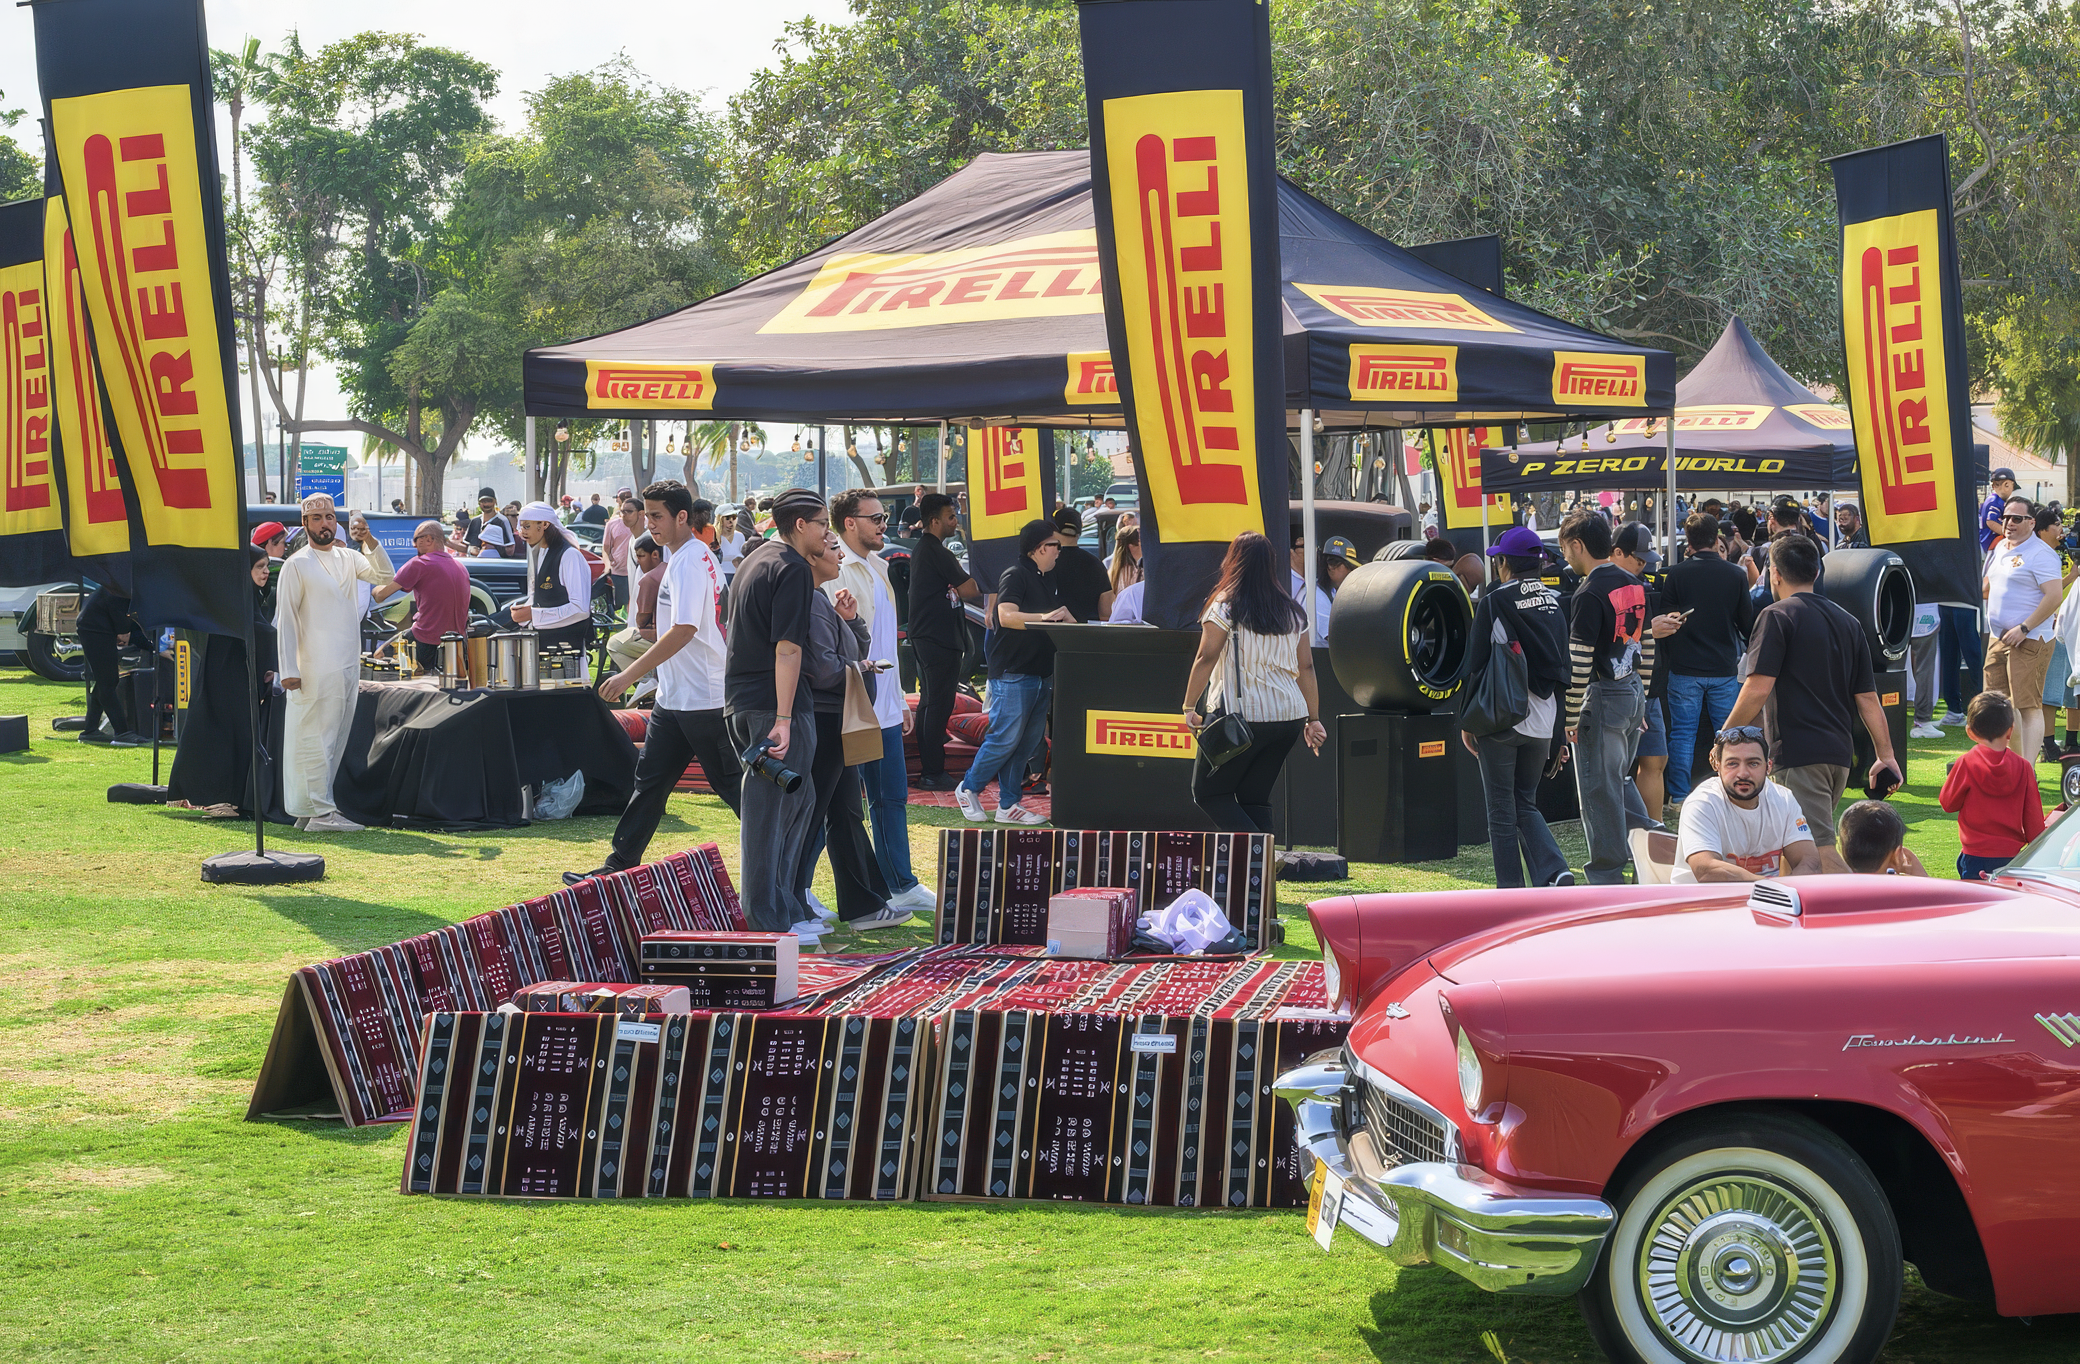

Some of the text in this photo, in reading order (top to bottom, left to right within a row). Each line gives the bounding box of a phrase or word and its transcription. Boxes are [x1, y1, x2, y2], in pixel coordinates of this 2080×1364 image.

[83, 133, 212, 510] PIRELLI
[1135, 133, 1249, 506] PIRELLI
[1319, 294, 1493, 327] PIRELLI
[595, 369, 704, 400] PIRELLI
[1357, 354, 1448, 391] PIRELLI
[1559, 362, 1638, 397] PIRELLI
[1861, 244, 1938, 516] PIRELLI
[2, 288, 51, 513] PIRELLI
[1521, 456, 1786, 476] P ZERO WORLD
[1095, 718, 1193, 750] PIRELLI
